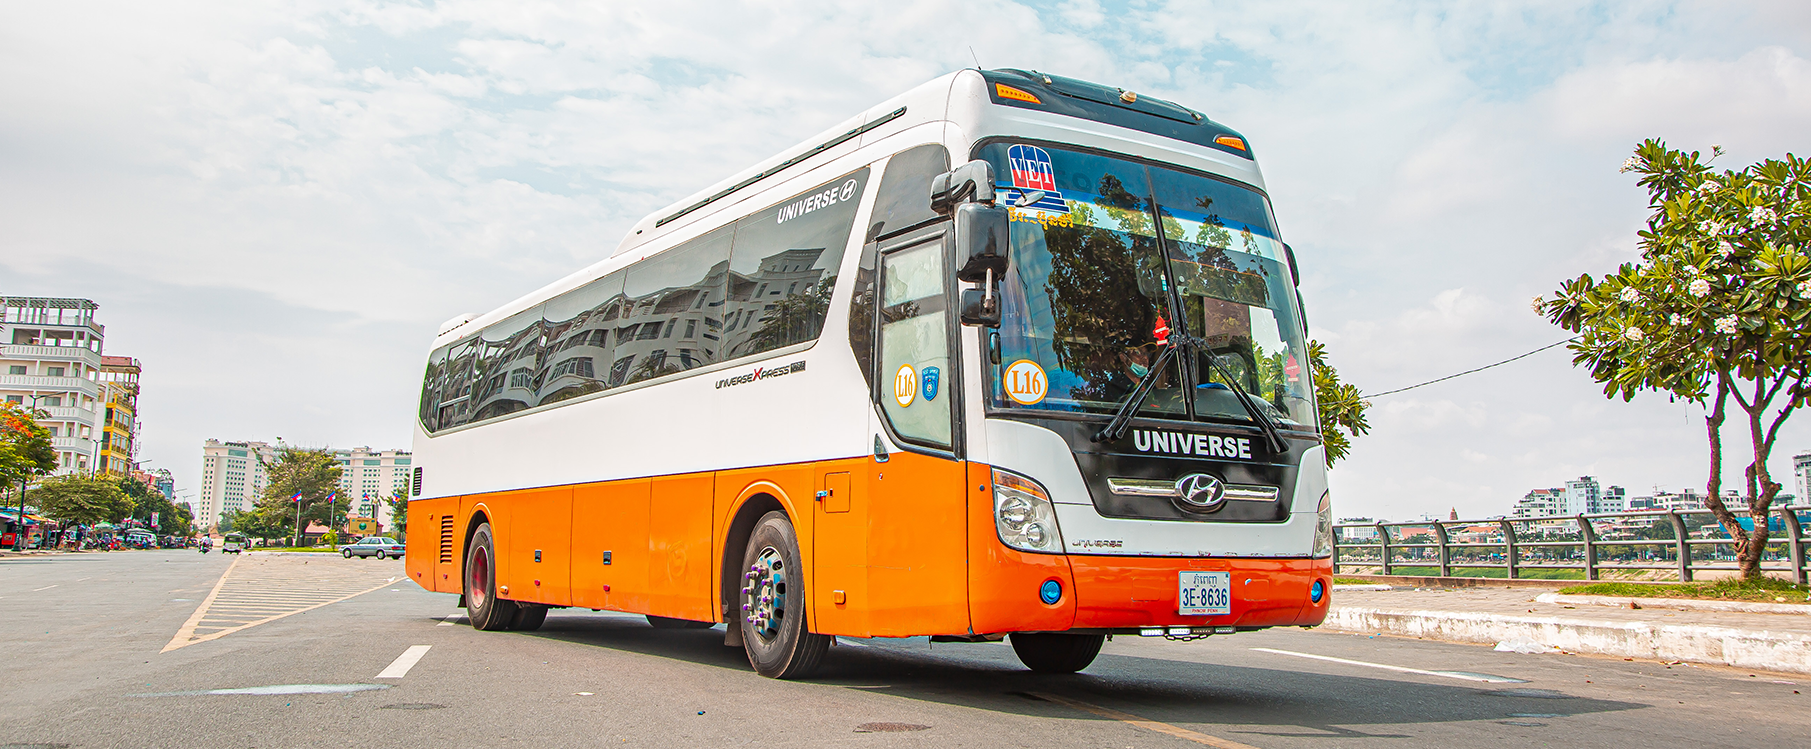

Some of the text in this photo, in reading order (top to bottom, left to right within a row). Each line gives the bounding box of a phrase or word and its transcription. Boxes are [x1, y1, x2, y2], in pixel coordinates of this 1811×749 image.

[1010, 157, 1052, 184] VET
[777, 187, 839, 224] UNIVERSE
[898, 373, 913, 398] L16
[1011, 370, 1041, 395] L16
[1132, 429, 1252, 460] UNIVERSE
[1182, 587, 1228, 606] 3E-8636
